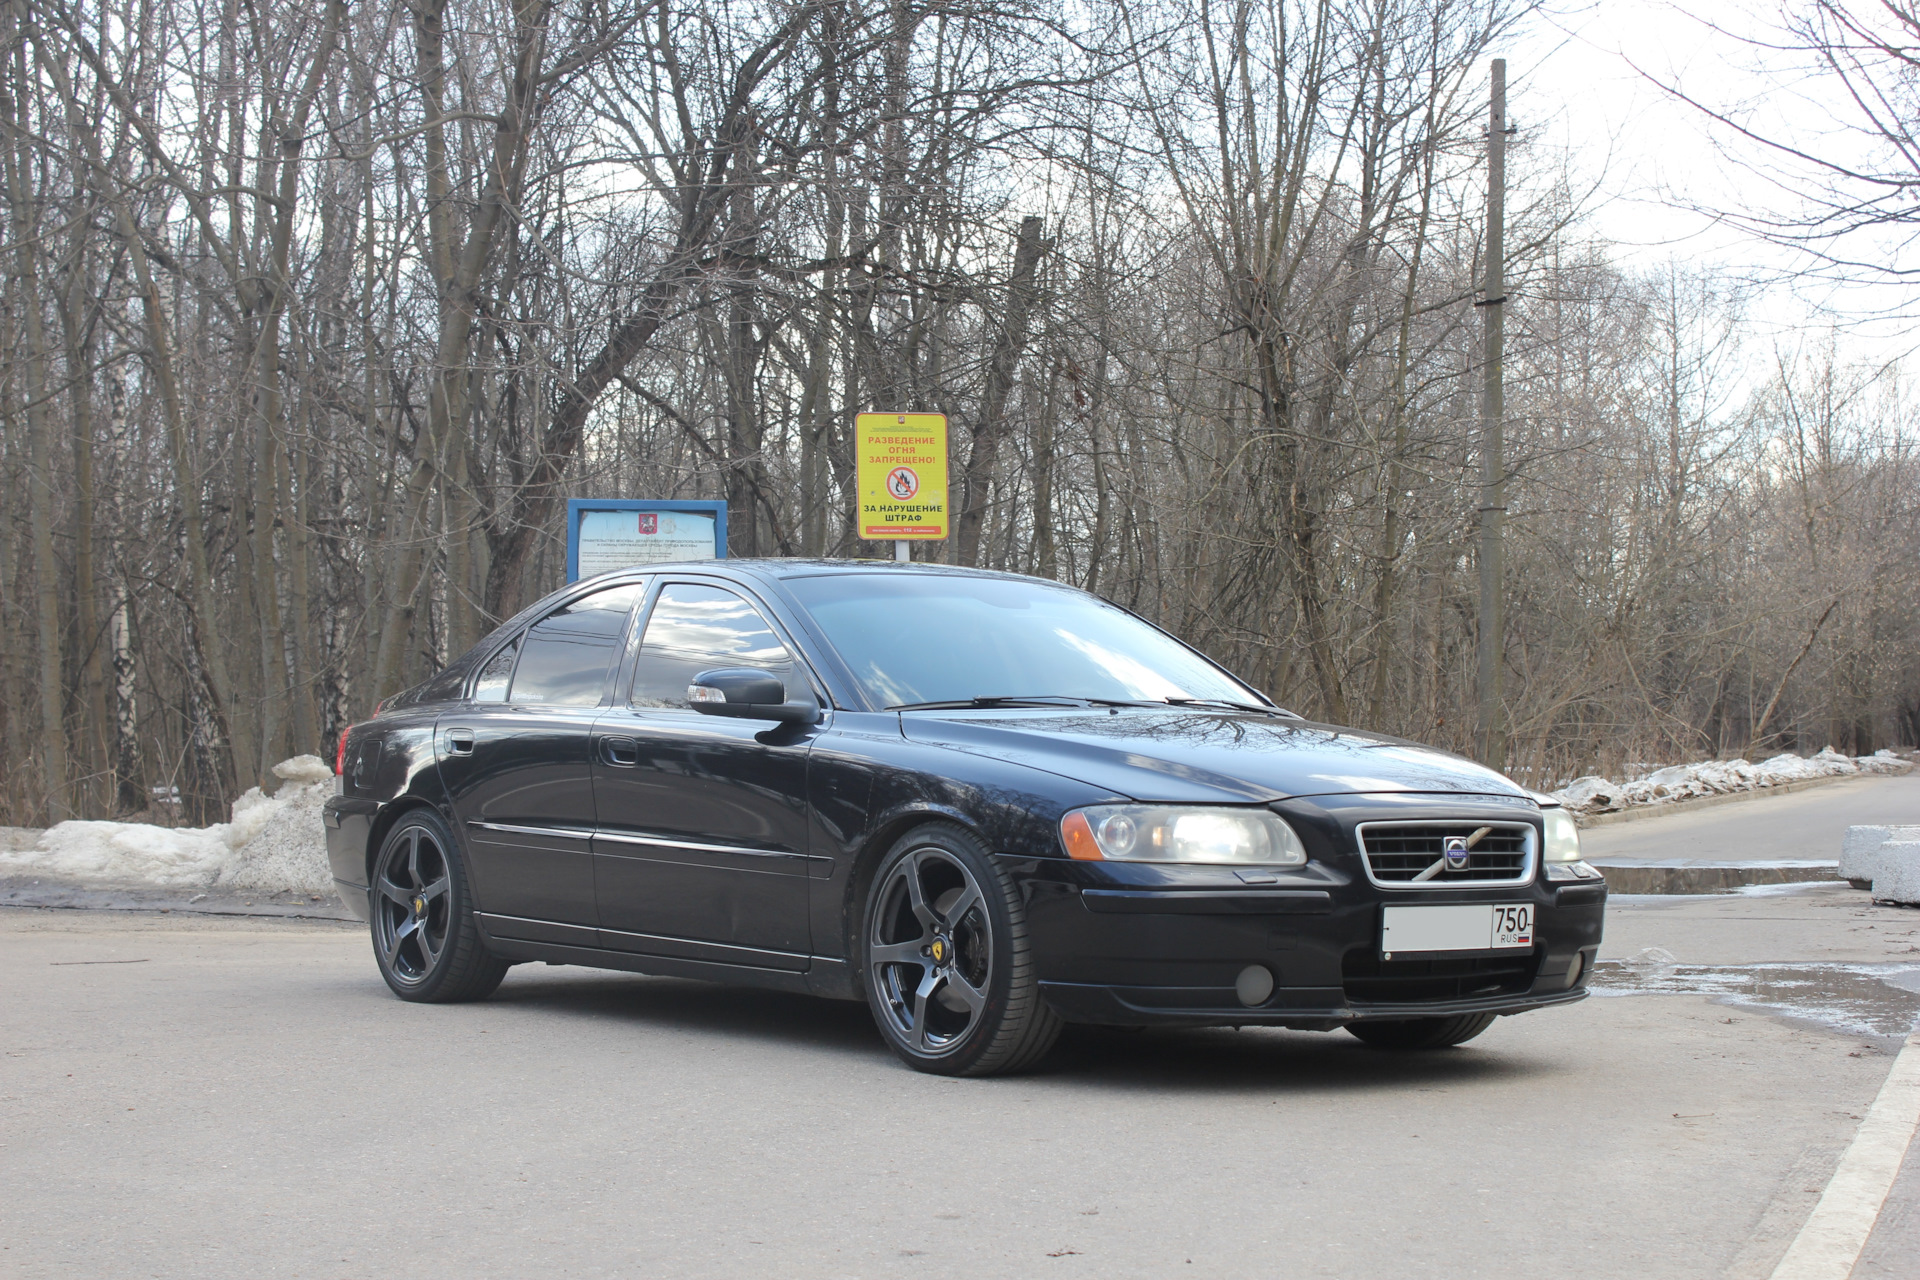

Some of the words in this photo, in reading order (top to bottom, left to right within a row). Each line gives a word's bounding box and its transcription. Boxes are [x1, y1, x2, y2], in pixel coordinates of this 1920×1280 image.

[868, 436, 936, 445] РАЗВЕДЕНИЕ
[888, 446, 916, 454] ОГНЯ
[868, 456, 936, 464] ЗАПРЕЩЕНО!
[885, 514, 922, 522] ШТРАФ
[1495, 907, 1528, 933] 750
[1500, 934, 1518, 943] RUS
